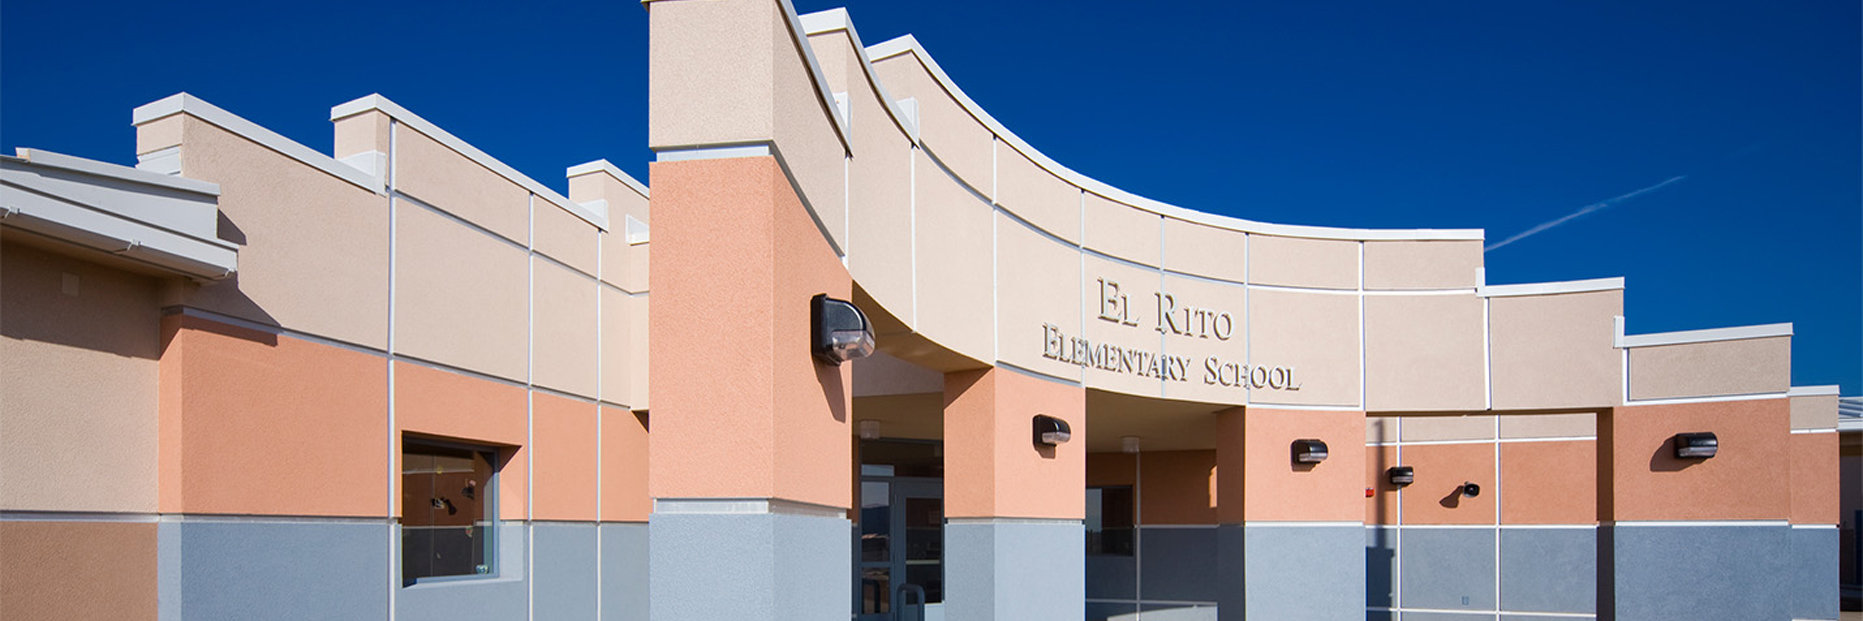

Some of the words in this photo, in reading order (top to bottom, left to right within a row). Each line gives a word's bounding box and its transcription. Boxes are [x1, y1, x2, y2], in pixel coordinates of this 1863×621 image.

[1097, 276, 1140, 327] EL
[1154, 291, 1235, 341] RITO
[1042, 322, 1192, 382] ELEMENTARY
[1204, 355, 1303, 391] SCHOOL
